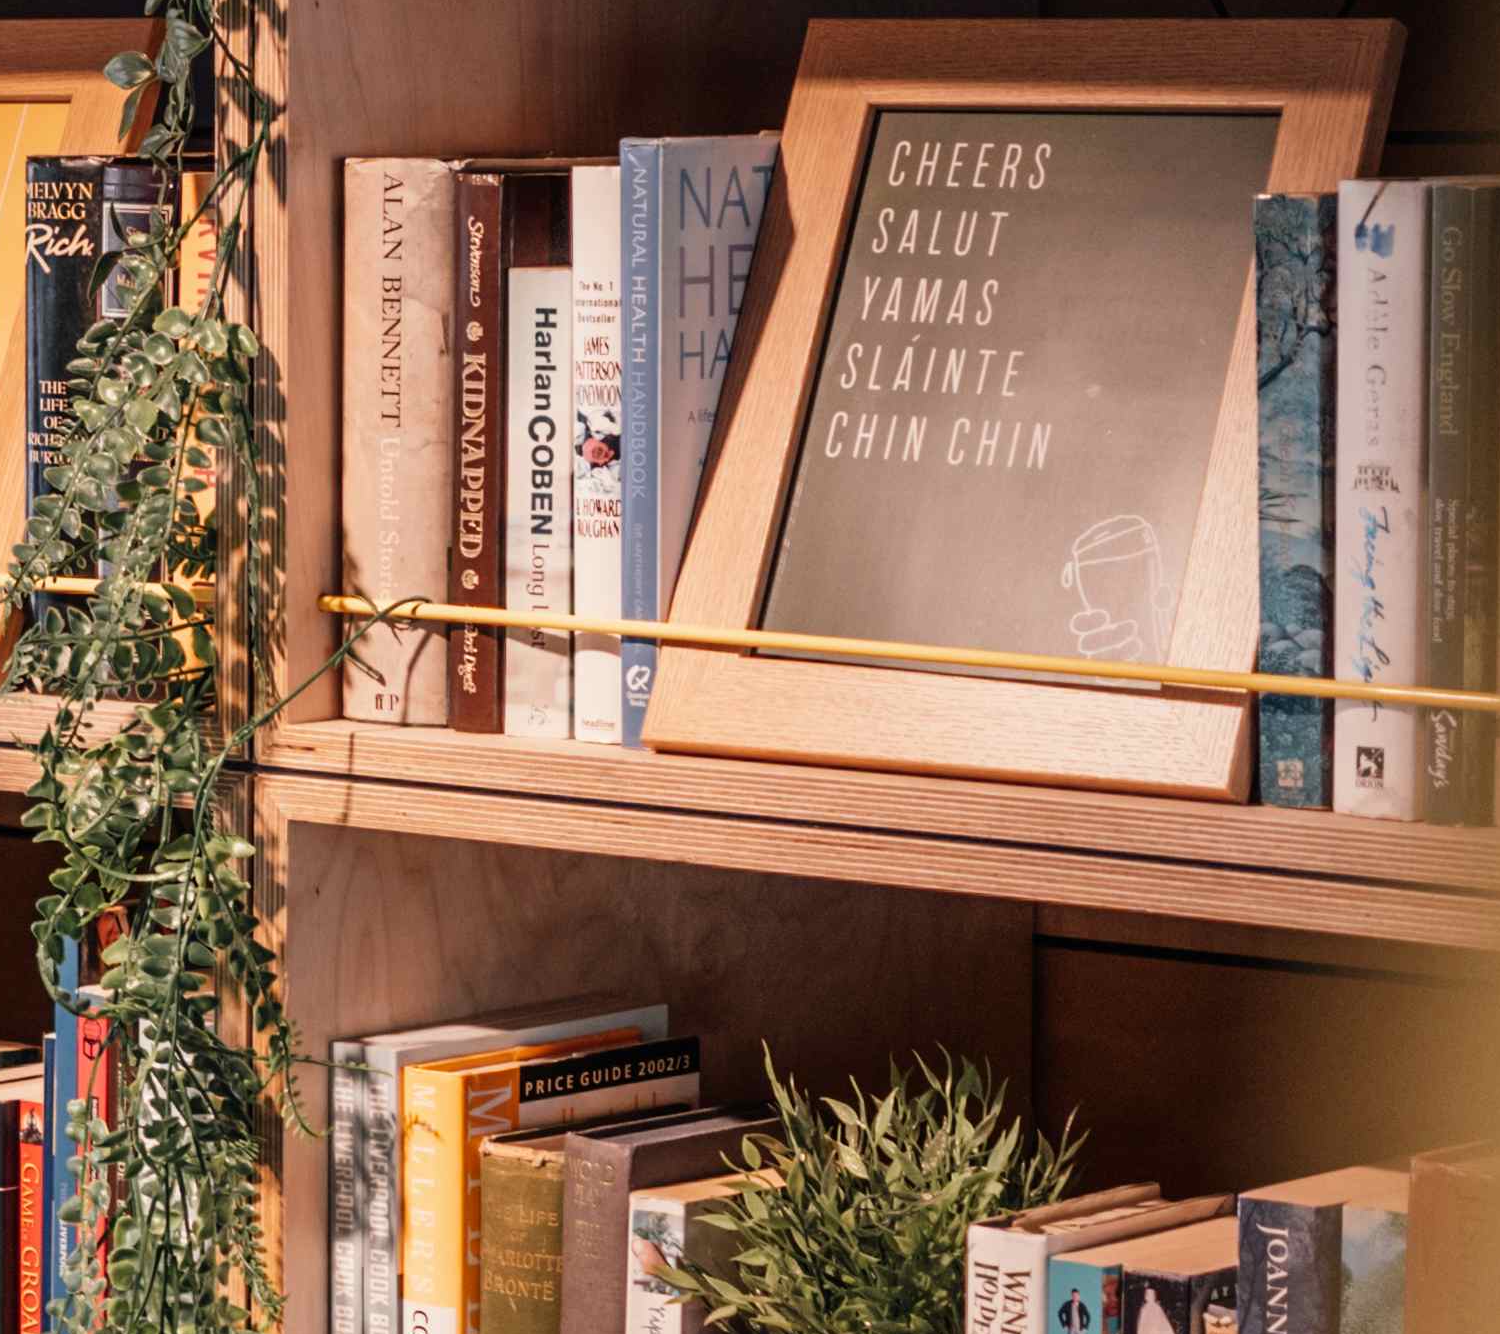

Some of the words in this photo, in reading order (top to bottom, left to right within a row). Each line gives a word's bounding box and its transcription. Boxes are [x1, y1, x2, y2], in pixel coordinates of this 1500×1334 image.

[888, 140, 1054, 190] CHEERS
[28, 203, 86, 220] BRAGG
[381, 174, 404, 262] ALAN
[630, 167, 647, 268] NATURAL
[870, 208, 1011, 259] SALUT
[630, 275, 647, 362] HEALTH
[858, 277, 1000, 328] YAMAS
[379, 276, 403, 428] BENNETT
[534, 306, 557, 413] Harlan
[839, 333, 1025, 400] SLÁINTE
[459, 350, 487, 559] KIDNAPPED
[629, 371, 645, 500] HANDBOOK
[825, 410, 925, 464] CHIN
[946, 416, 1052, 470] CHIN
[527, 414, 557, 537] COBEN
[524, 1073, 575, 1098] PRICE
[579, 1066, 634, 1090] GUIDE
[637, 1053, 692, 1081] 2002/3
[21, 1161, 41, 1228] GAME
[335, 1121, 360, 1235] LIVERPOOL
[333, 1241, 355, 1305] COOK
[369, 1248, 391, 1305] COOK
